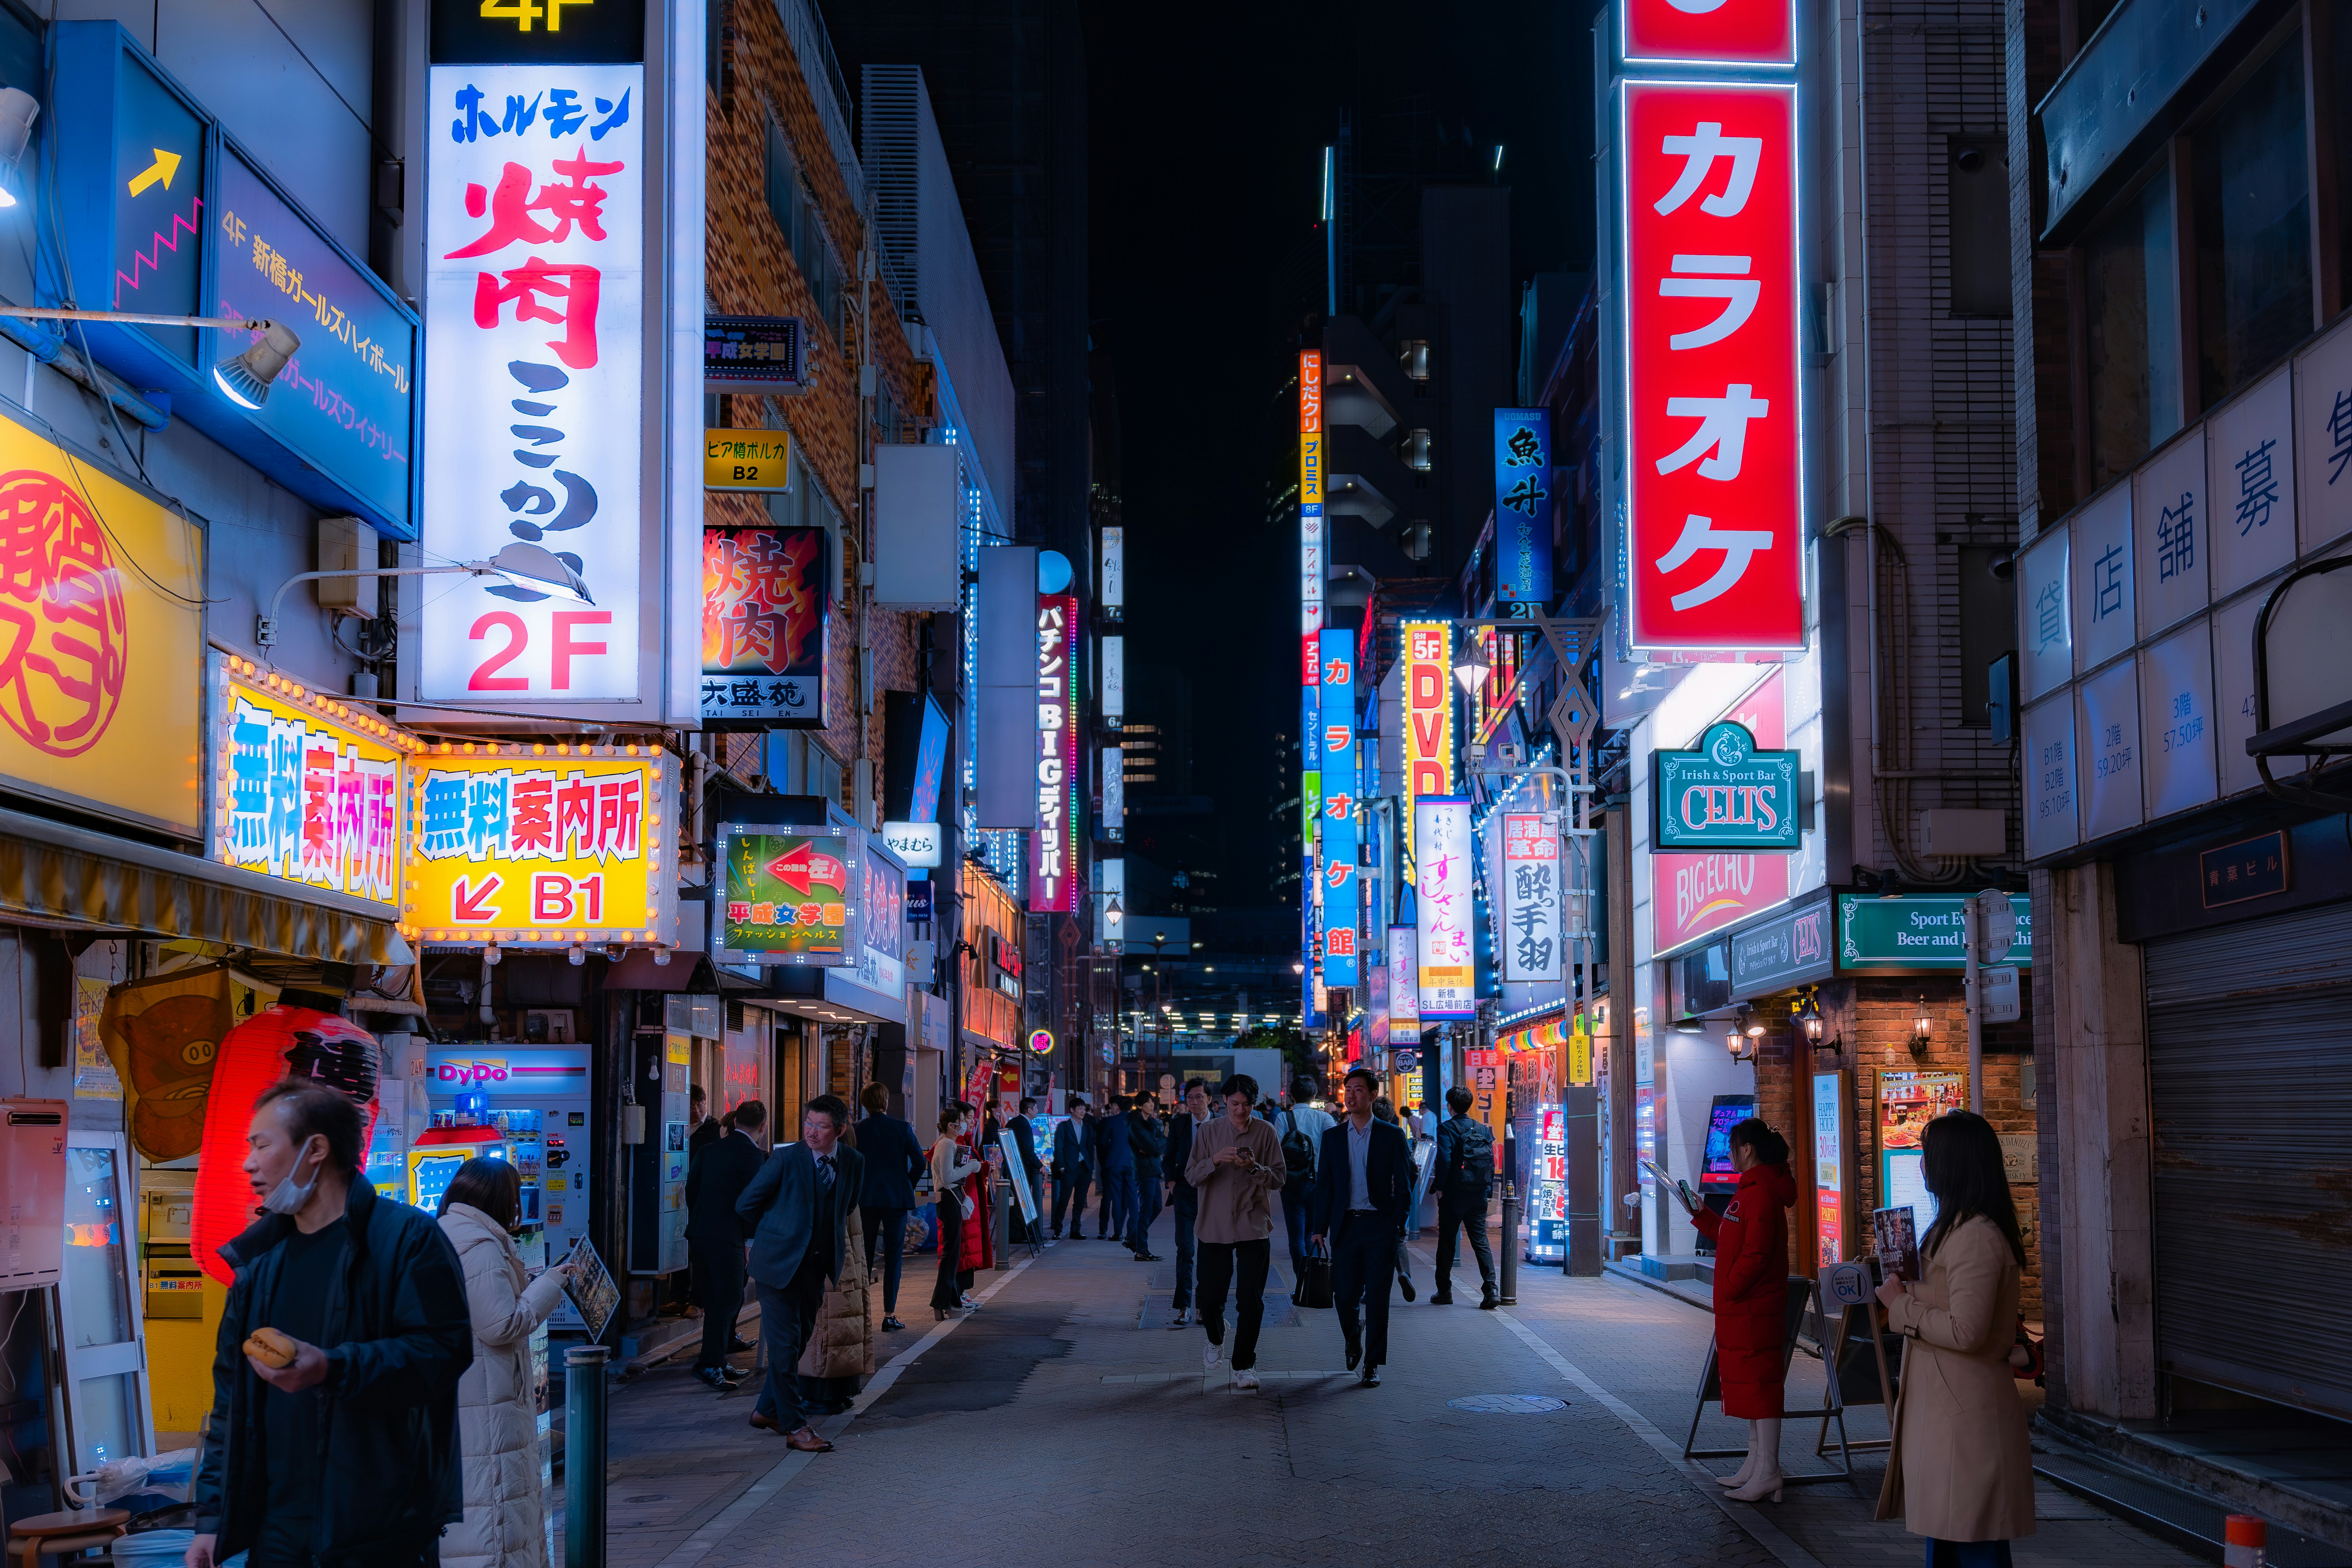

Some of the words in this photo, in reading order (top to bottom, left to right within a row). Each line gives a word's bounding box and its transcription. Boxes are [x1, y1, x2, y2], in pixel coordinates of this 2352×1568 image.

[452, 84, 630, 143] ホルモン
[443, 143, 625, 369] 焼肉
[222, 210, 246, 247] 4F
[253, 234, 409, 393] 新橋ガールズハイボール
[706, 341, 785, 360] 平成女学園
[1653, 122, 1773, 611] カラオケ
[251, 326, 407, 463] ガールズワイナリー
[1303, 354, 1319, 432] にしだクリ
[708, 440, 784, 460] ビア樽ポルカ
[733, 466, 758, 481] B2
[1305, 440, 1318, 495] プロミス
[1305, 505, 1318, 514] 8F
[1307, 548, 1316, 594] アイフル
[1518, 523, 1532, 592] 和食居酒屋
[711, 534, 795, 674] 焼肉
[1109, 607, 1120, 618] 7F
[468, 611, 612, 690] 2F
[1307, 641, 1319, 673] アコム
[1414, 641, 1439, 659] 5F
[702, 680, 808, 708] 大盛苑
[2173, 691, 2191, 719] 3階
[1108, 716, 1121, 727] 6F
[1412, 663, 1446, 795] DVD
[2106, 724, 2121, 747] 2階
[2164, 716, 2204, 752] 57.50坪
[1308, 711, 1318, 761] セントラル
[1038, 605, 1062, 898] パチンコBIGディッパー
[2044, 740, 2063, 766] B1階
[2097, 747, 2131, 779] 59.20坪
[1682, 769, 1710, 779] Irish
[1713, 771, 1720, 779] &
[1723, 769, 1755, 782] Sport
[1757, 770, 1775, 779] Bar
[2045, 767, 2063, 791] B2階
[232, 713, 396, 891] 無料案内所
[424, 777, 639, 853] 無料案内所
[1325, 657, 1356, 957] カラオケ館
[1681, 785, 1777, 831] CELTS
[2040, 791, 2070, 819] 95.10坪
[1109, 829, 1122, 839] 5F
[1444, 808, 1452, 839] つきじ
[887, 837, 933, 852] やまむら
[1508, 839, 1557, 858] 革命
[776, 864, 808, 872] この路地
[808, 858, 837, 878] 左!
[2209, 856, 2278, 886] 青葉ビル
[535, 876, 601, 920] B1
[1421, 854, 1470, 963] すしざんまい
[1677, 861, 1704, 929] BIG
[728, 901, 845, 926] 平成女学園
[1512, 862, 1555, 971] 酔っ手羽
[1911, 911, 1948, 929] Sport
[734, 929, 837, 940] ファッションヘルス
[1747, 941, 1756, 956] Irish
[1757, 944, 1760, 953] &
[1760, 938, 1771, 954] Sport
[1793, 911, 1820, 965] CELTS
[1898, 932, 1927, 945] Beer
[1931, 932, 1958, 945] and
[1392, 956, 1418, 1016] すしざんまい
[1428, 977, 1465, 987] 年中無休
[1438, 989, 1455, 998] 新橋
[1423, 1000, 1472, 1009] SL広場前店
[410, 1060, 424, 1077] 24K
[439, 1064, 508, 1085] DyDo
[1818, 1102, 1835, 1116] HAPPY
[1819, 1116, 1835, 1131] HOUR
[2005, 1136, 2032, 1150] DANIEL'S
[1542, 1189, 1554, 1218] 焼き鳥
[1821, 1206, 1837, 1222] PARTY
[160, 1279, 203, 1290] 無料案内所
[1838, 1285, 1857, 1296] OK
